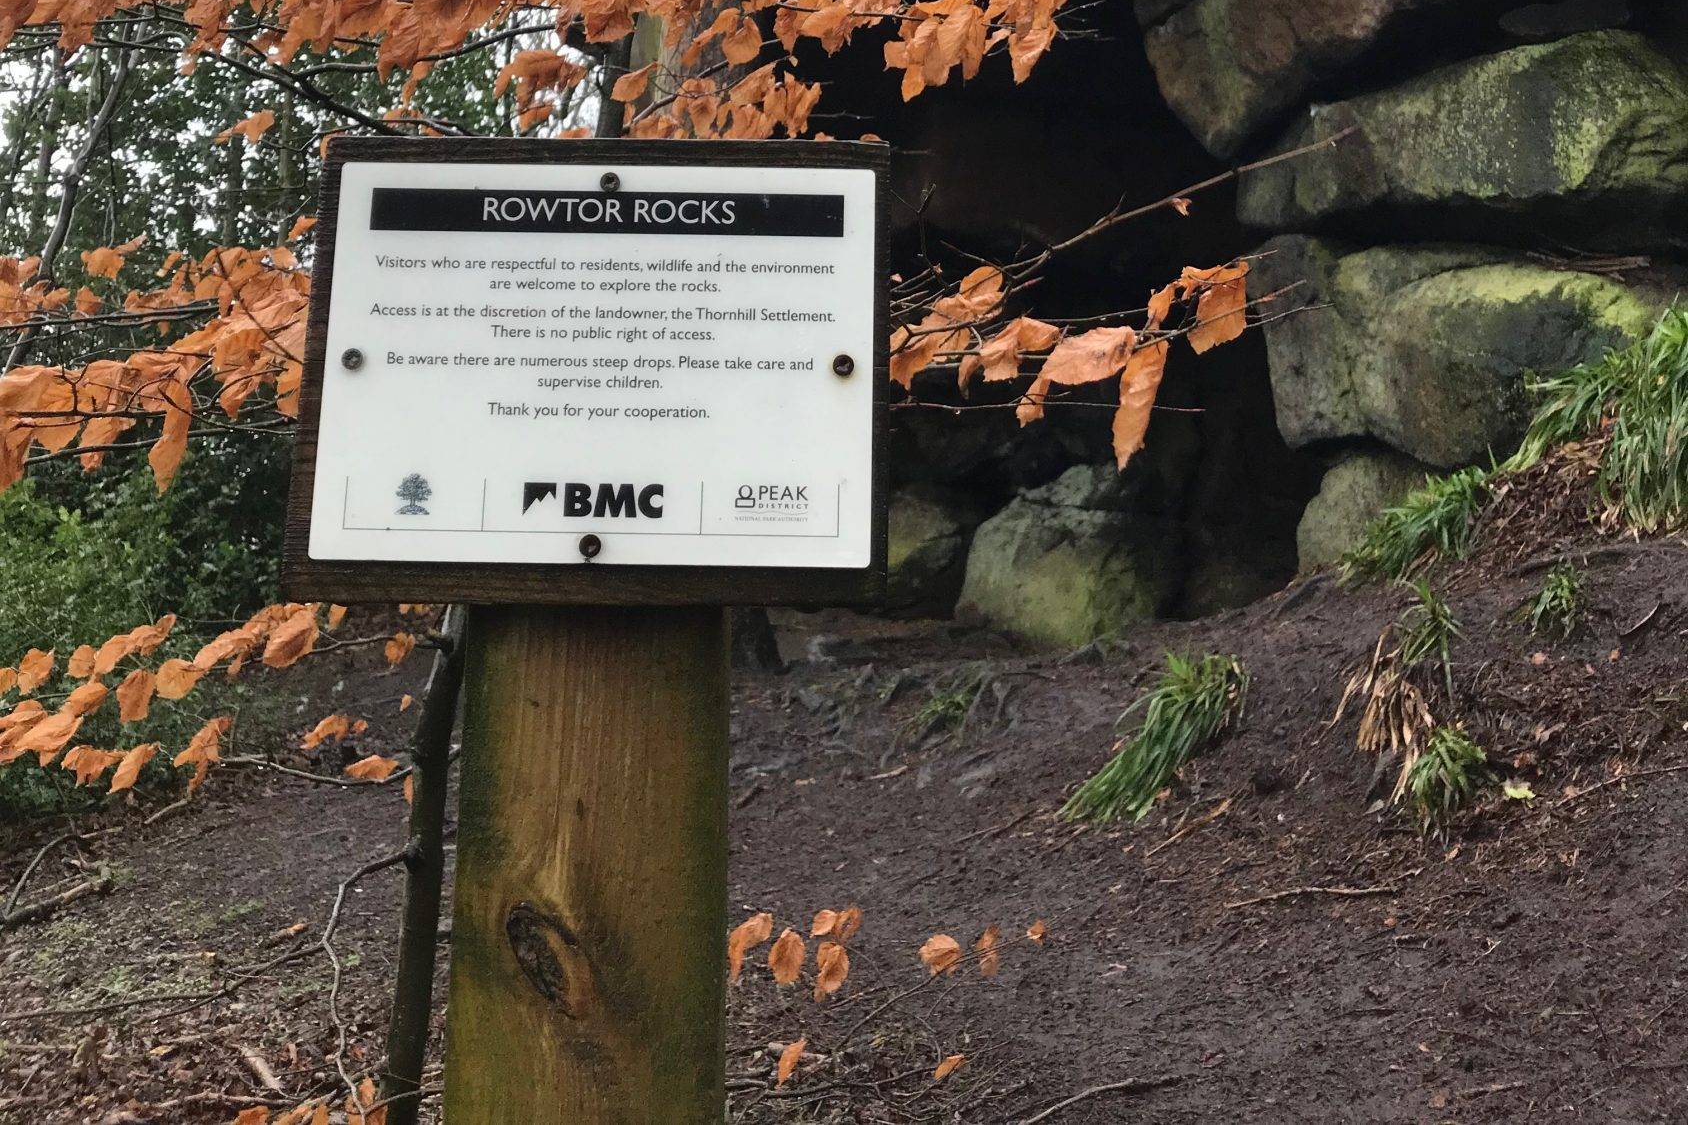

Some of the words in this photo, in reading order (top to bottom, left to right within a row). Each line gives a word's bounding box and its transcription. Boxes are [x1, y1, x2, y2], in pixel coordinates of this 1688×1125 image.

[482, 197, 624, 223] ROWTOR
[633, 199, 736, 225] ROCKS
[375, 254, 427, 269] Visitors
[431, 255, 461, 269] who
[464, 260, 487, 270] are
[490, 257, 557, 274] respectful
[560, 260, 576, 271] to
[580, 258, 644, 273] residents,
[646, 259, 693, 273] wildlife
[696, 260, 721, 273] and
[725, 260, 747, 273] the
[751, 261, 835, 275] environment
[489, 280, 512, 290] are
[515, 277, 576, 291] welcome
[580, 280, 596, 291] to
[599, 278, 651, 295] explore
[655, 278, 677, 292] the
[681, 279, 721, 293] rocks.
[369, 302, 417, 317] Access
[421, 304, 432, 317] is
[435, 306, 450, 317] at
[453, 304, 476, 317] the
[479, 304, 547, 318] discretion
[551, 305, 567, 319] of
[568, 305, 591, 319] the
[595, 305, 668, 322] landowner,
[670, 306, 693, 320] the
[694, 307, 756, 321] Thornhill
[760, 307, 836, 323] Settlement.
[490, 324, 532, 339] There
[535, 325, 546, 339] is
[550, 329, 568, 339] no
[572, 326, 612, 343] public
[616, 326, 649, 344] right
[651, 326, 667, 340] of
[669, 330, 716, 341] access.
[386, 351, 404, 365] Be
[408, 355, 449, 366] aware
[453, 352, 490, 366] there
[493, 356, 516, 367] are
[520, 357, 588, 368] numerous
[592, 356, 629, 372] steep
[633, 354, 675, 372] drops.
[678, 355, 720, 370] Please
[724, 356, 753, 370] take
[756, 360, 786, 370] care
[789, 357, 814, 371] and
[537, 375, 602, 392] supervise
[605, 375, 663, 389] children.
[487, 401, 530, 416] Thank
[533, 406, 559, 420] you
[562, 403, 584, 417] for
[587, 407, 620, 421] your
[623, 405, 710, 422] cooperation.
[563, 482, 664, 519] BMC
[758, 485, 808, 501] PEAK
[758, 502, 809, 510] DISTRICT
